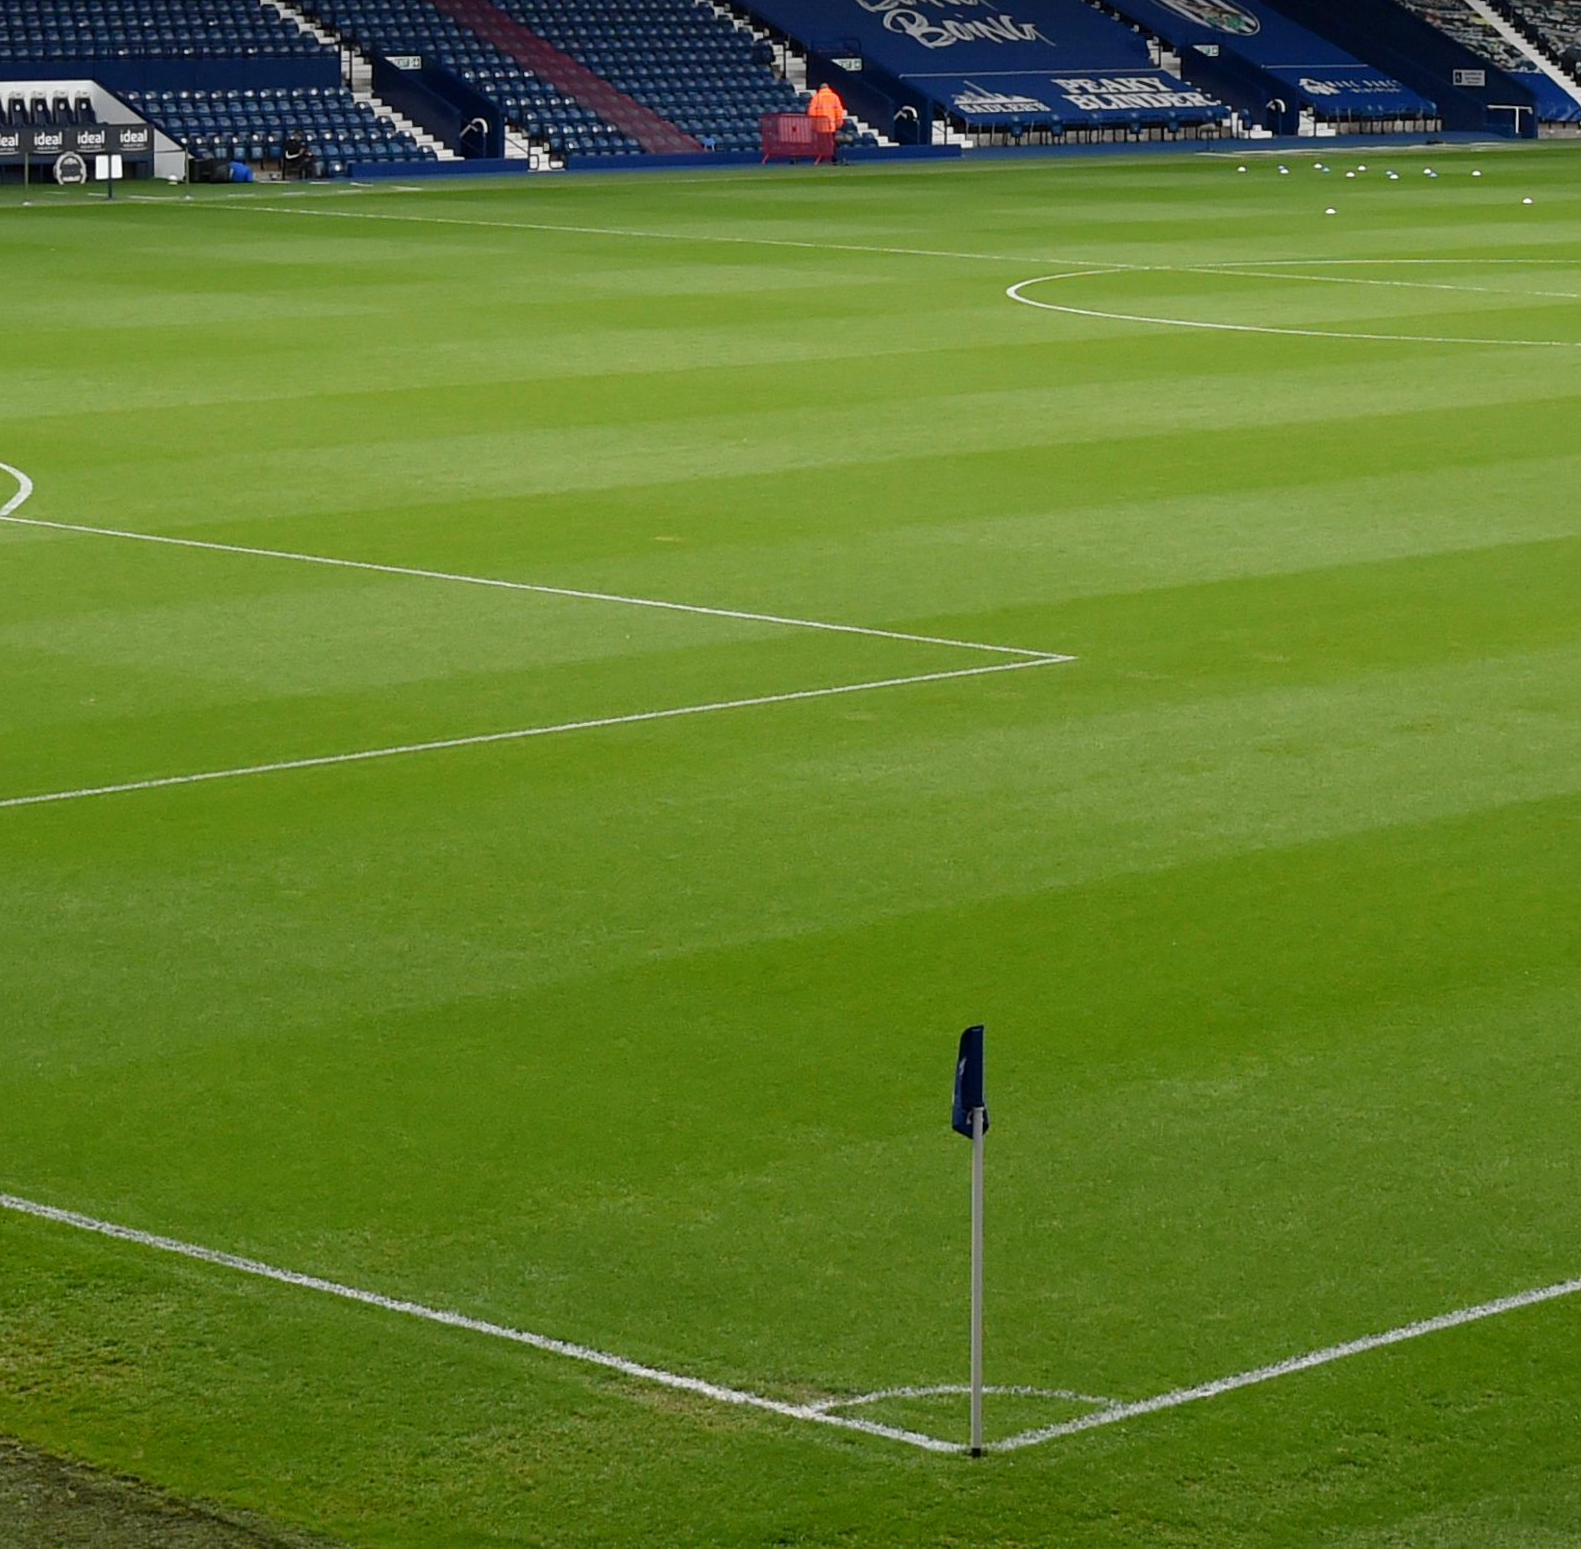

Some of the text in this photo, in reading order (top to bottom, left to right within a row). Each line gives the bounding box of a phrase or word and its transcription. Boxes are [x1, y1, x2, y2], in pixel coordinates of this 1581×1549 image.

[1051, 77, 1172, 94] PEAKY
[1062, 91, 1213, 110] BLINDER
[33, 131, 63, 146] ideal
[77, 129, 105, 145] ideal
[120, 128, 148, 143] ideal
